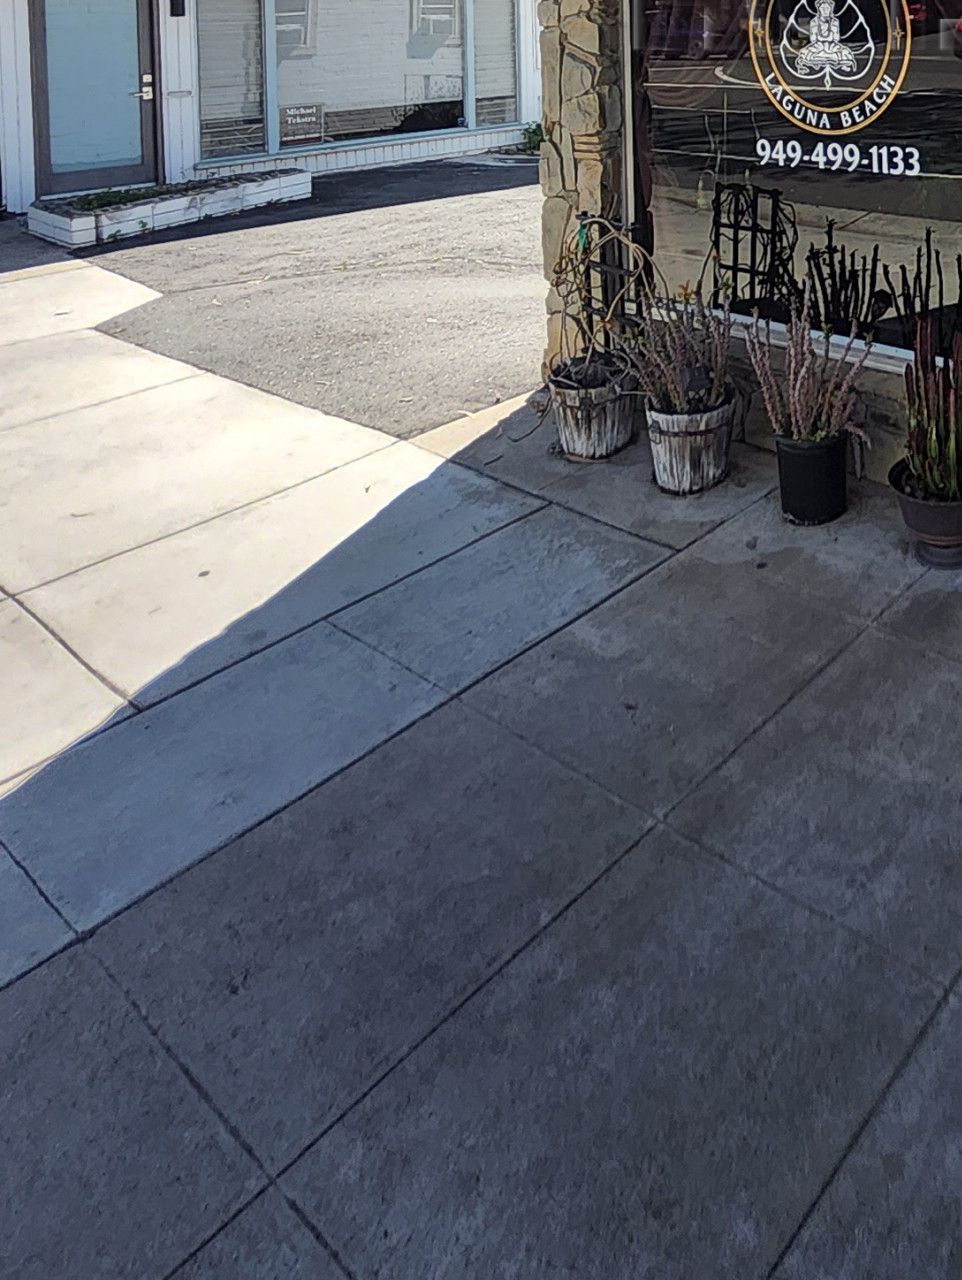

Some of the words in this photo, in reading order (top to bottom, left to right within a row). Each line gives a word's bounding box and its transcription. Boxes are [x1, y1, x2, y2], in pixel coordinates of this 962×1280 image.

[764, 71, 831, 129] LAGUNA
[841, 74, 897, 128] BEACH
[756, 138, 921, 176] 949-499-1133
